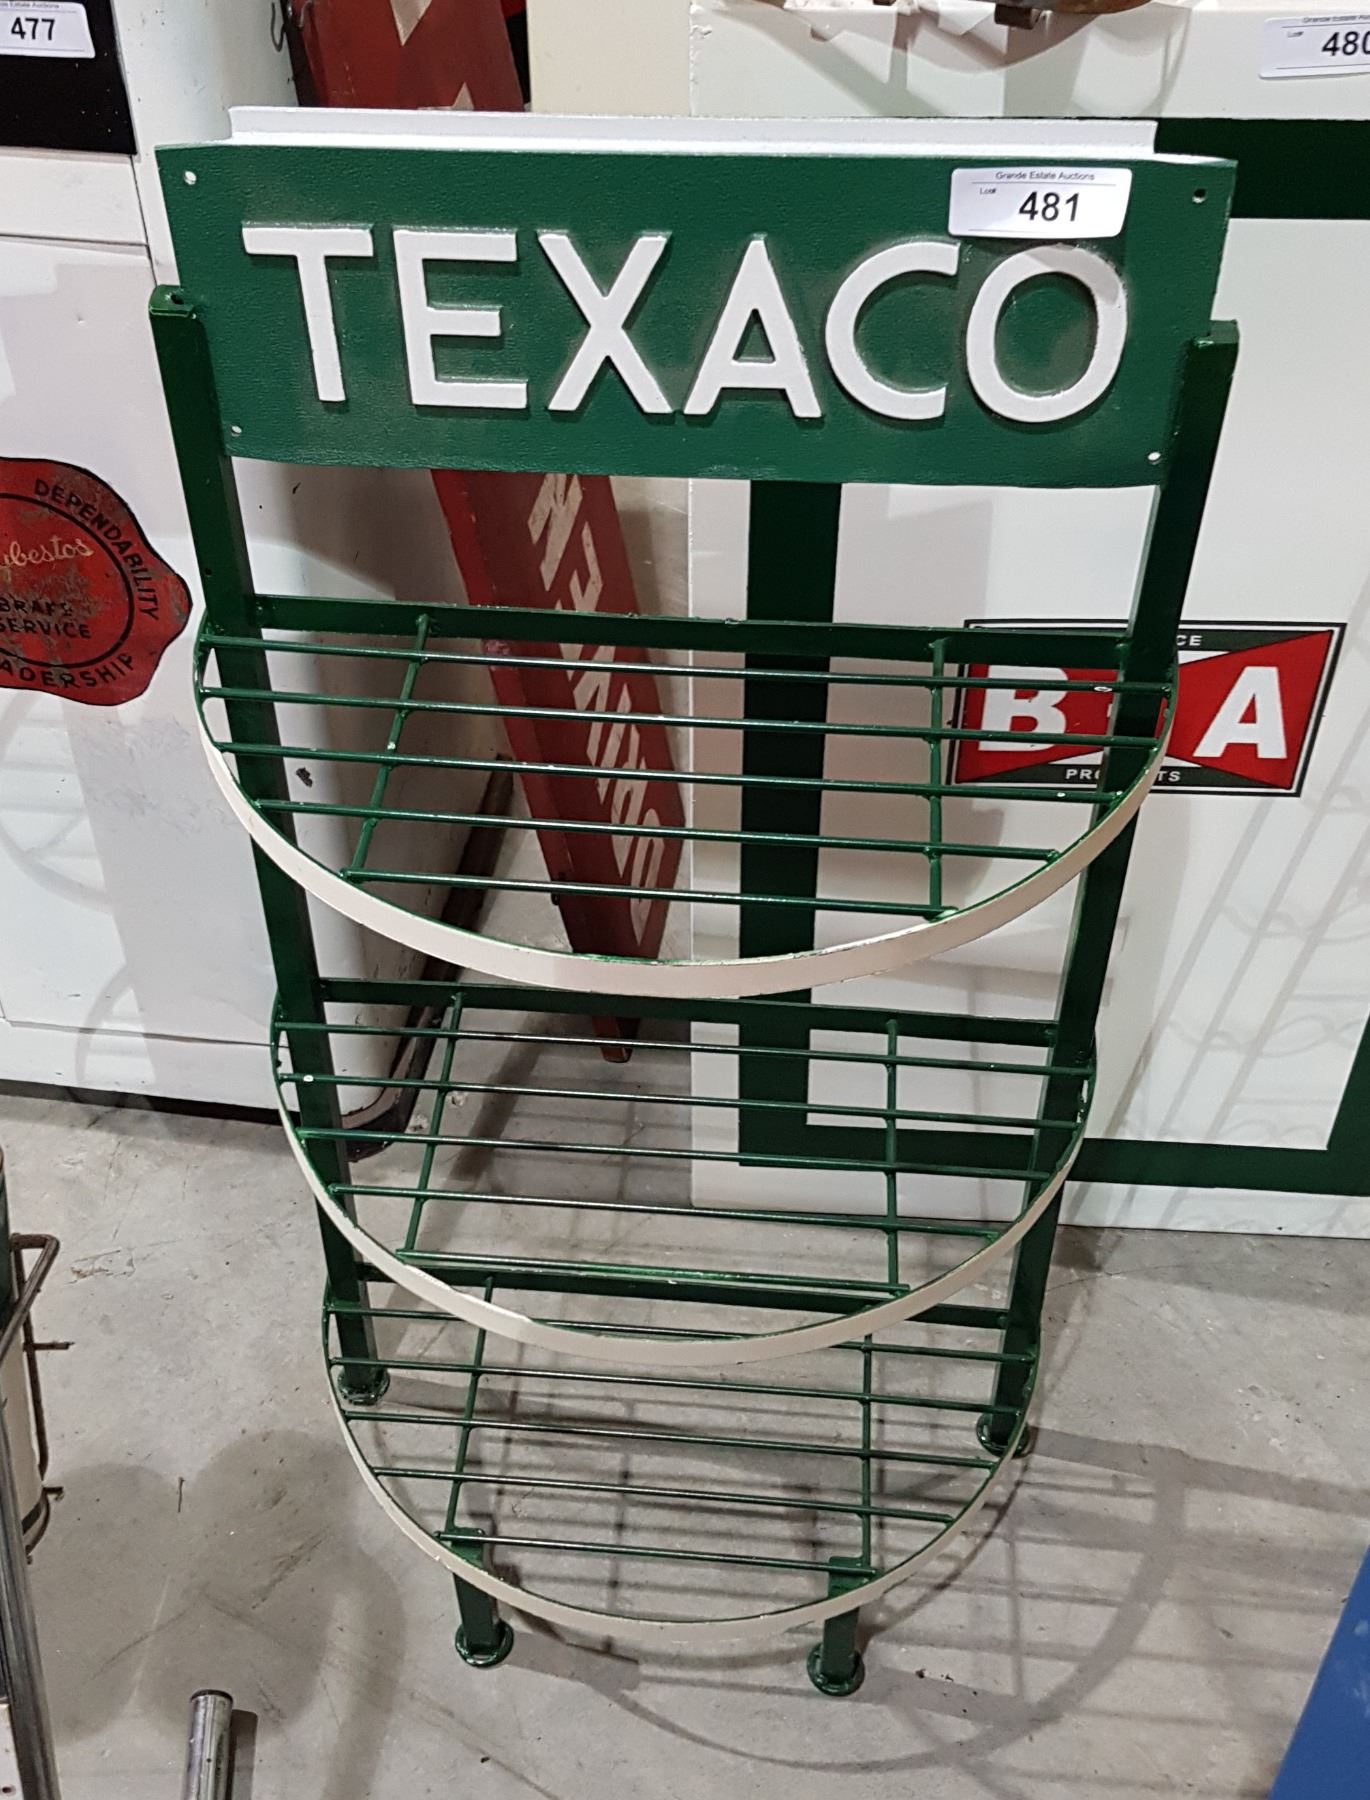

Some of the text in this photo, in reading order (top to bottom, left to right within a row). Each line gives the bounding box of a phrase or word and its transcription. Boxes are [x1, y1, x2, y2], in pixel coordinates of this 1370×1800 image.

[11, 17, 55, 40] 477
[995, 171, 1095, 181] Grande Estate Auctions
[1018, 190, 1080, 222] 481
[242, 222, 1129, 424] TEXACO
[34, 478, 159, 621] DEPENDABILITY
